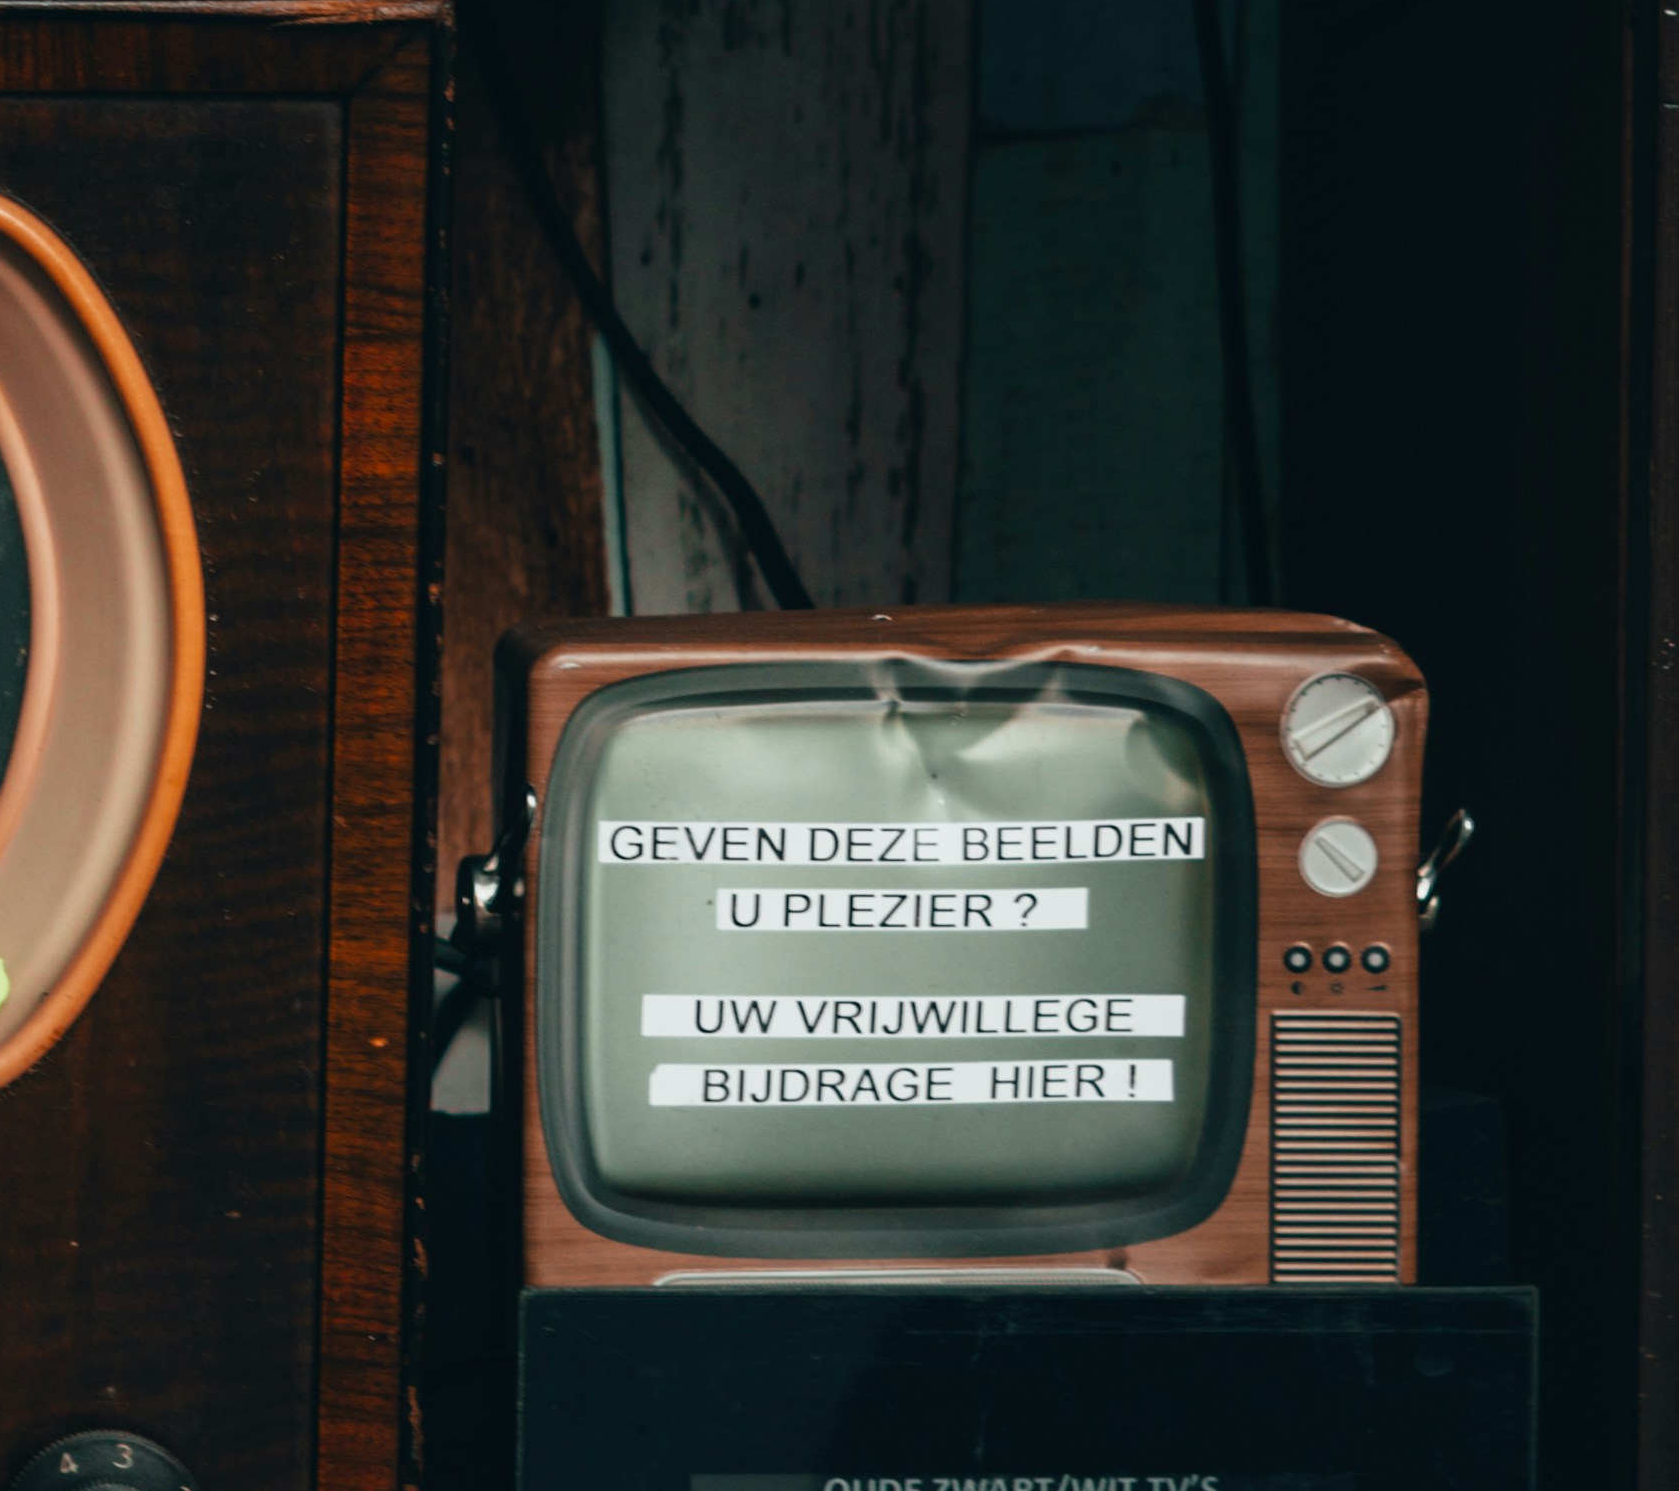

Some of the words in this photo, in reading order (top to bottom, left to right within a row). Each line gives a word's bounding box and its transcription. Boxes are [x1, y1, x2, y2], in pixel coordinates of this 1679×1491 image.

[610, 825, 786, 861] GEVEN
[809, 827, 939, 863] DEZE
[963, 822, 1193, 860] BEELDEN
[731, 893, 761, 928] U
[783, 893, 992, 928] PLEZIER
[695, 999, 777, 1034] UW
[796, 998, 1133, 1035] VRIJWILLEGE
[703, 1067, 953, 1103] BIJDRAGE
[990, 1064, 1105, 1100] HIER
[60, 1451, 79, 1474] 4
[112, 1443, 134, 1469] 3
